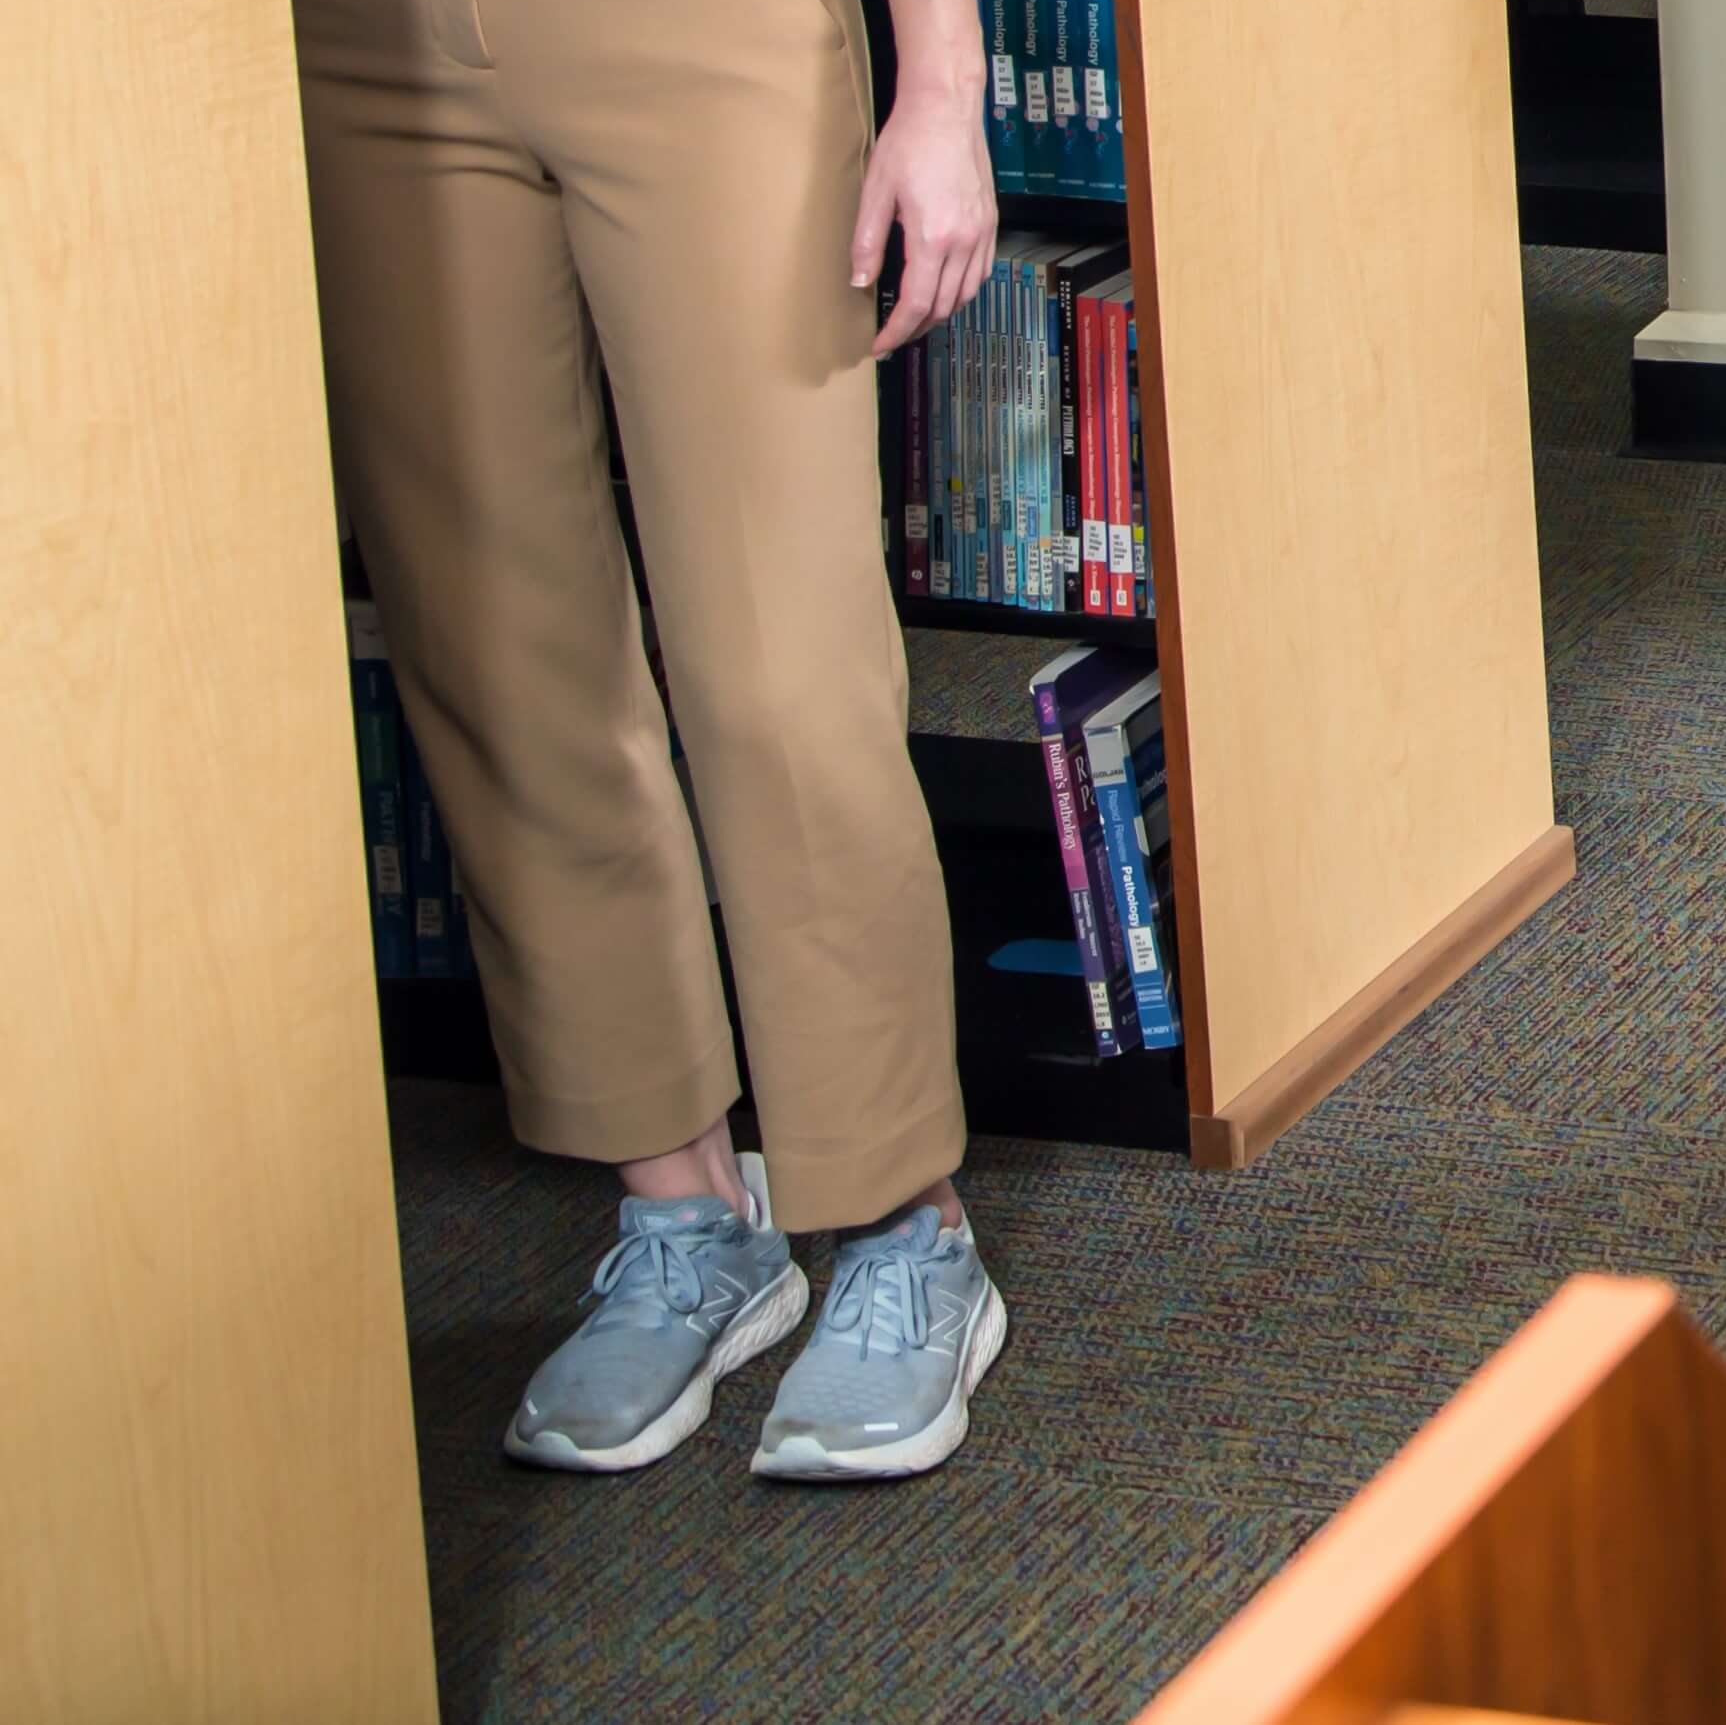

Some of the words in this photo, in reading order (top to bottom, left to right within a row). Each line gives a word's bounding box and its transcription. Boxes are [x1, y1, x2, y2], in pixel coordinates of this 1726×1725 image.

[1056, 0, 1068, 63] Pathology
[1088, 4, 1099, 66] Pathology
[1062, 405, 1075, 456] PATHOLOGY
[1048, 743, 1066, 789] Rubin's
[1056, 790, 1076, 852] Pathology
[1107, 789, 1121, 824] Rapid
[1115, 825, 1127, 864] Review
[1121, 866, 1139, 927] Pathology
